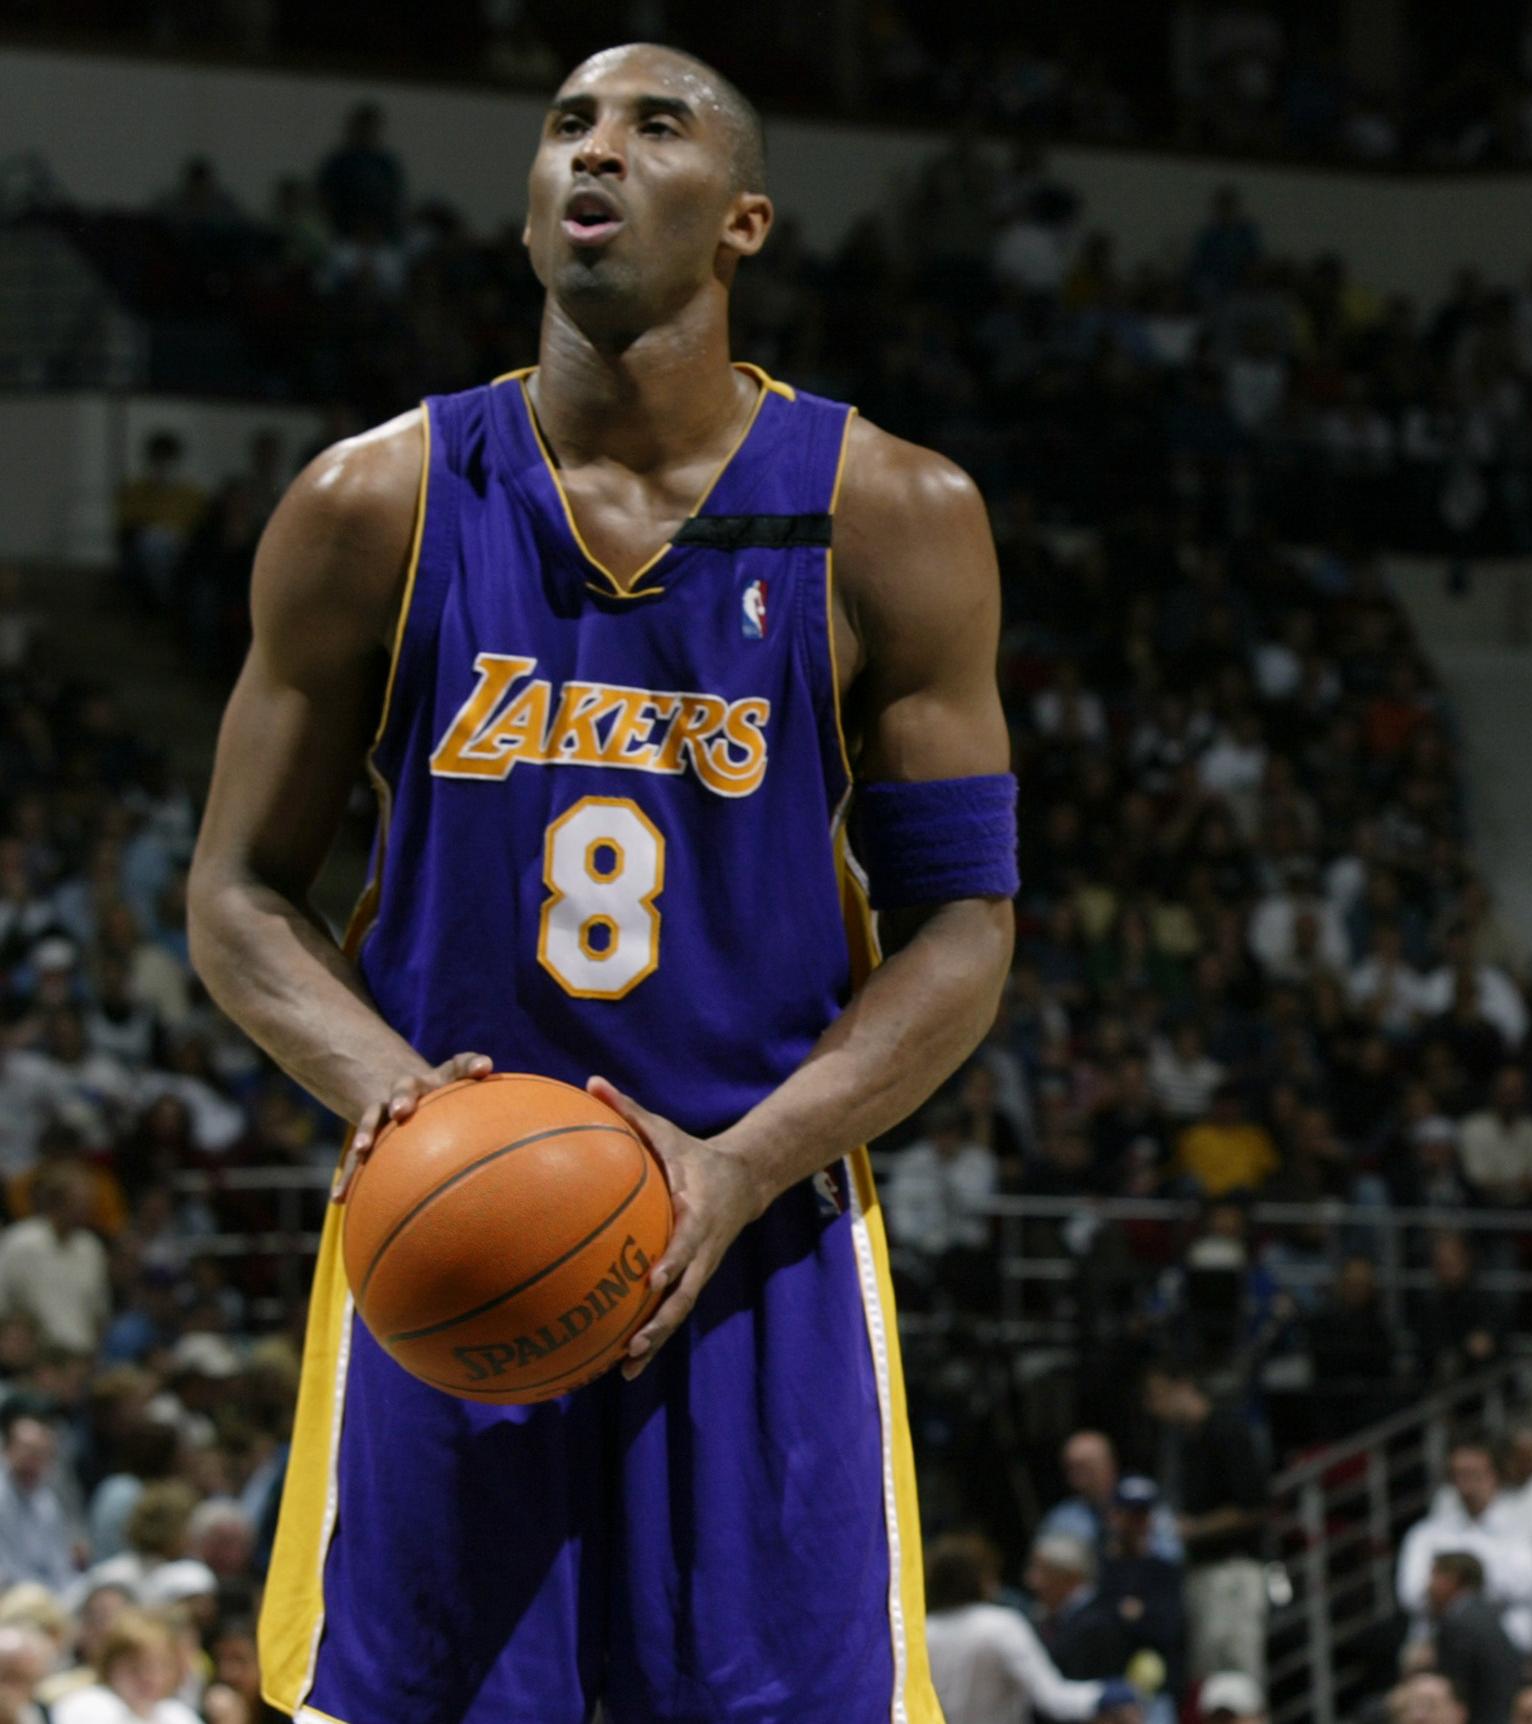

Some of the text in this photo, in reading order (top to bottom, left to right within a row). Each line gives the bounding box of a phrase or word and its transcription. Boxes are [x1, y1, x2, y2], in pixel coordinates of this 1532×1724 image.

[430, 652, 769, 798] LAKERS
[537, 795, 665, 1000] 8
[453, 1234, 650, 1381] SPALDING
